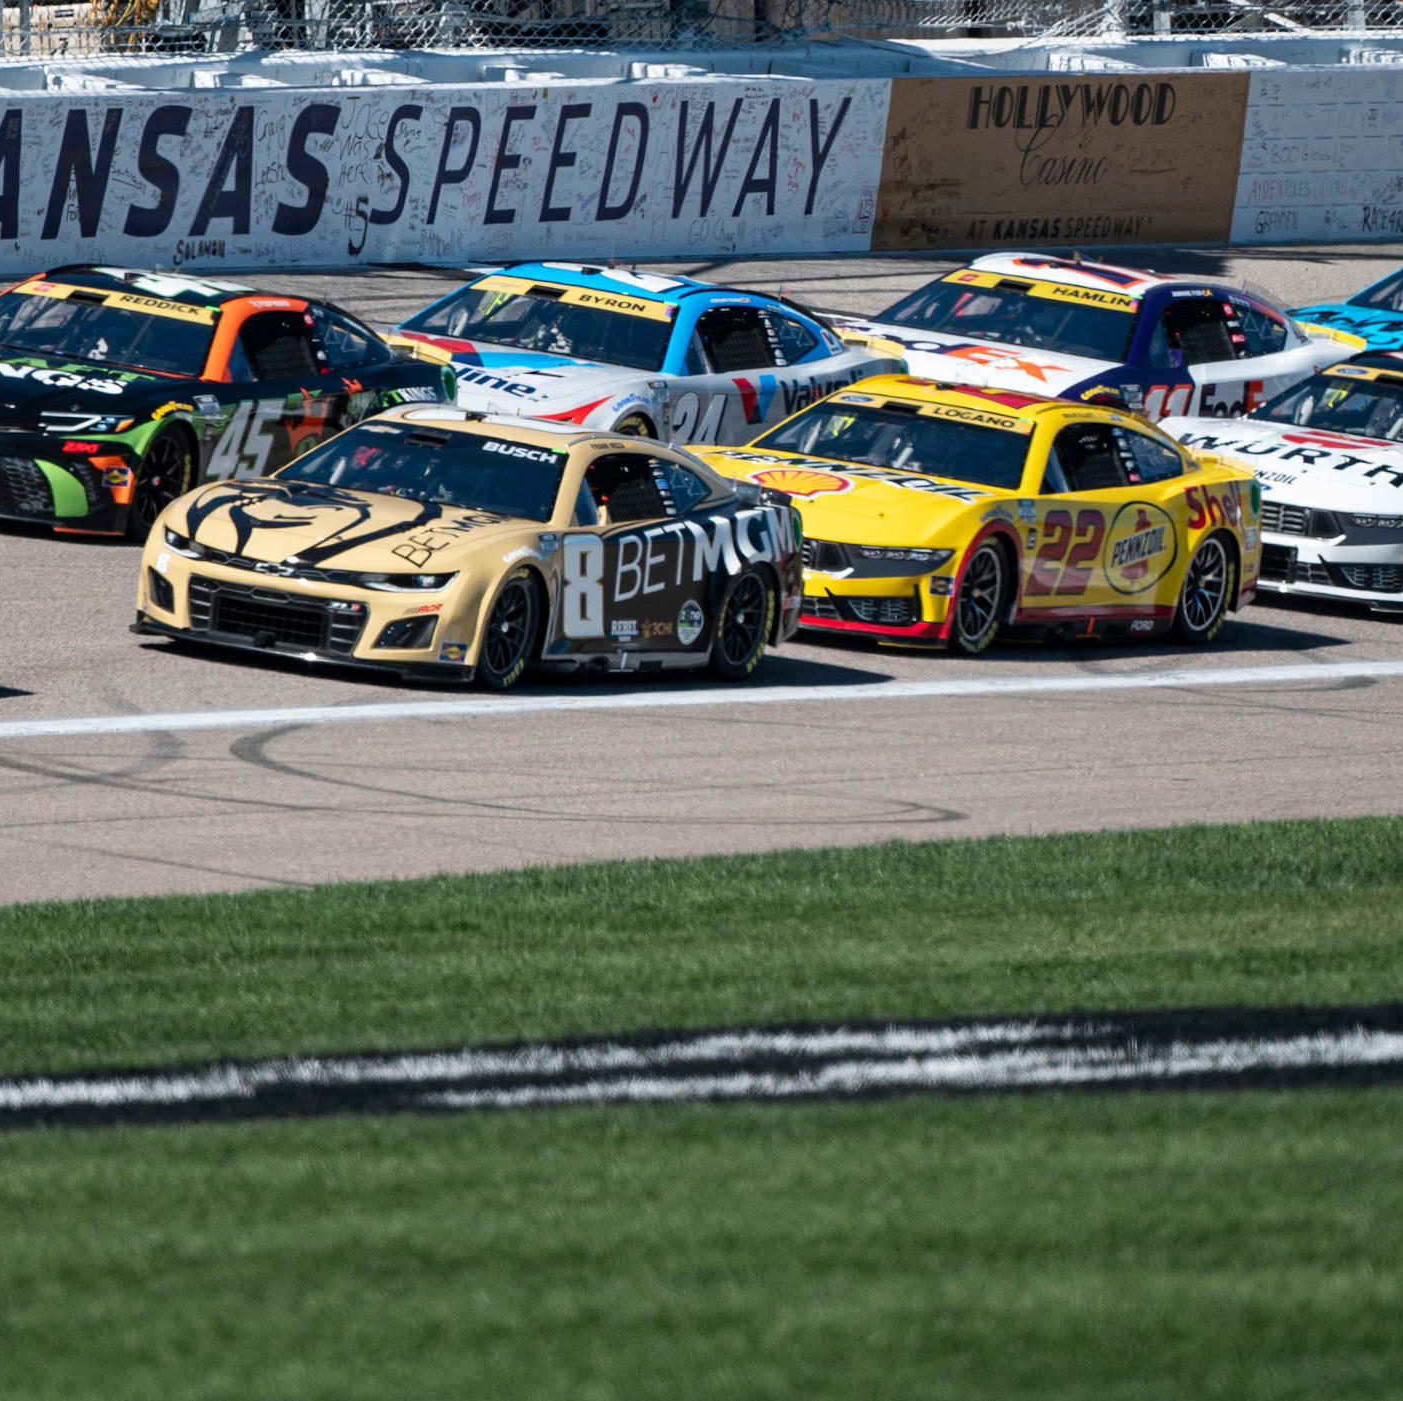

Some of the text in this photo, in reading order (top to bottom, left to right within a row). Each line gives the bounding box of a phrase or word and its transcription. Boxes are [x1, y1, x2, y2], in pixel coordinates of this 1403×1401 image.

[967, 82, 1176, 130] HOLLYWOOD
[370, 97, 854, 225] SPEEDWAY
[1015, 112, 1109, 186] Casino
[965, 216, 1144, 240] AT KANSAS SPEEDWAY
[119, 294, 201, 316] REDDICK
[578, 293, 646, 313] BYRON
[1052, 286, 1132, 307] HAMLIN
[207, 399, 288, 481] 45
[933, 406, 1015, 429] LOGANO
[482, 441, 559, 465] BUSCH
[1184, 479, 1243, 531] Shell
[614, 503, 795, 603] BETMGM
[1024, 508, 1106, 598] 22
[1110, 525, 1167, 570] PENNZOIL
[562, 531, 605, 640] 8
[611, 619, 639, 636] REBEL
[1130, 619, 1155, 632] FORD
